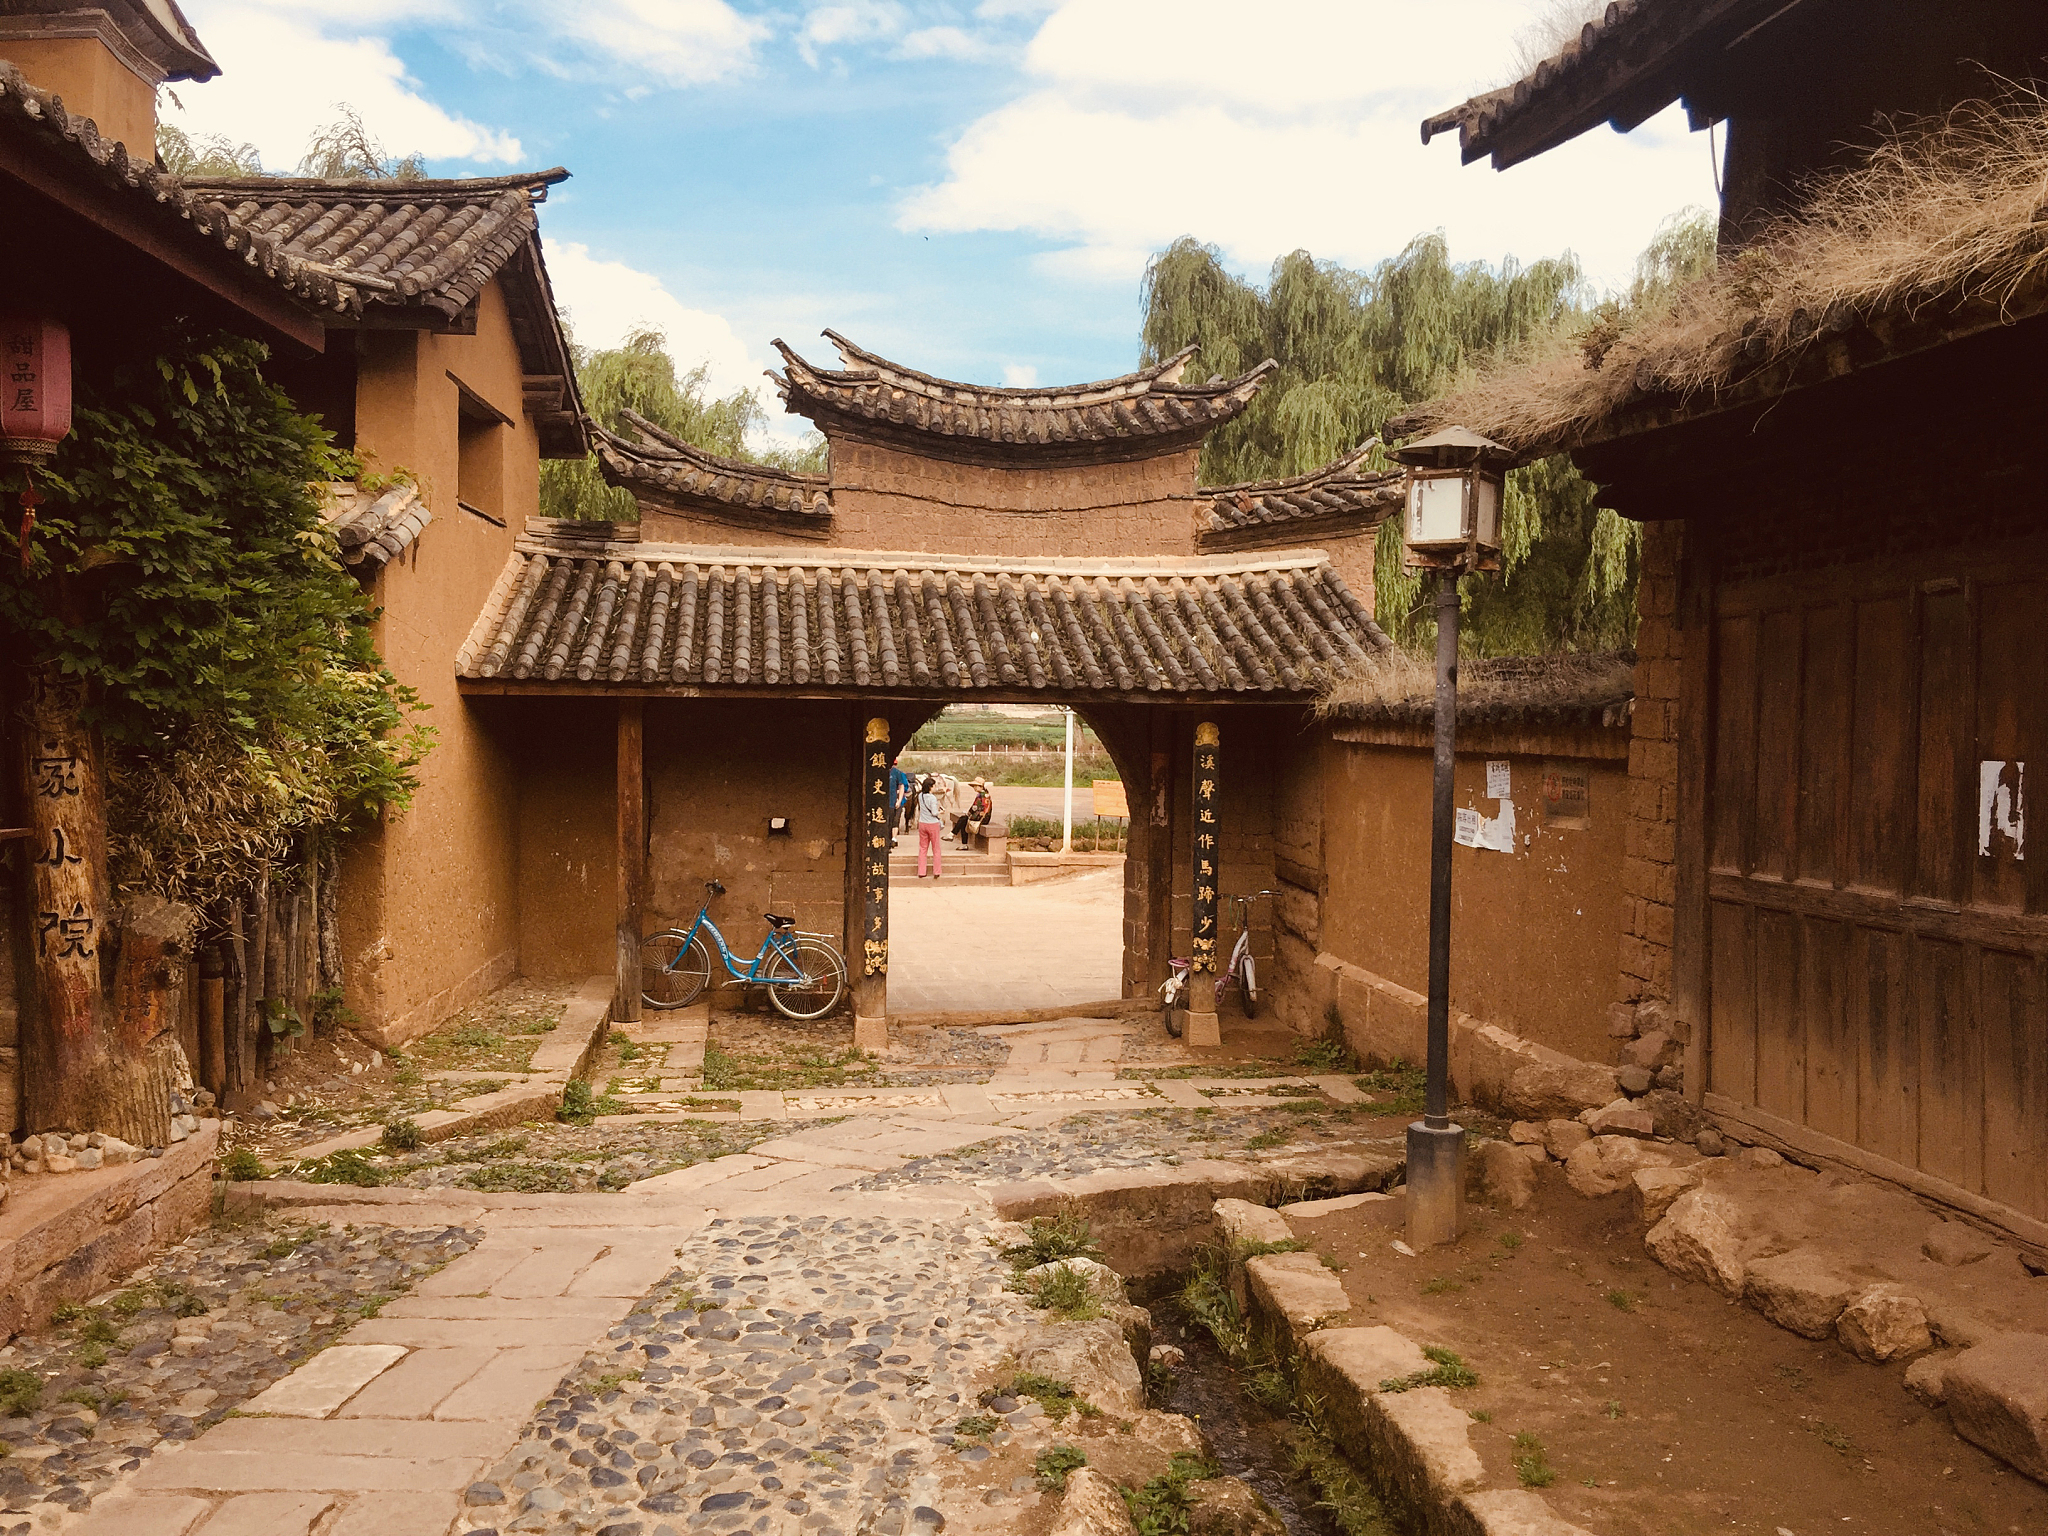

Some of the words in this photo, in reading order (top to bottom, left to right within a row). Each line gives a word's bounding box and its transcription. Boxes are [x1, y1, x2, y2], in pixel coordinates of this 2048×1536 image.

[9, 334, 38, 412] 甜品屋
[1198, 754, 1216, 933] 溪聲近作馬蹄少
